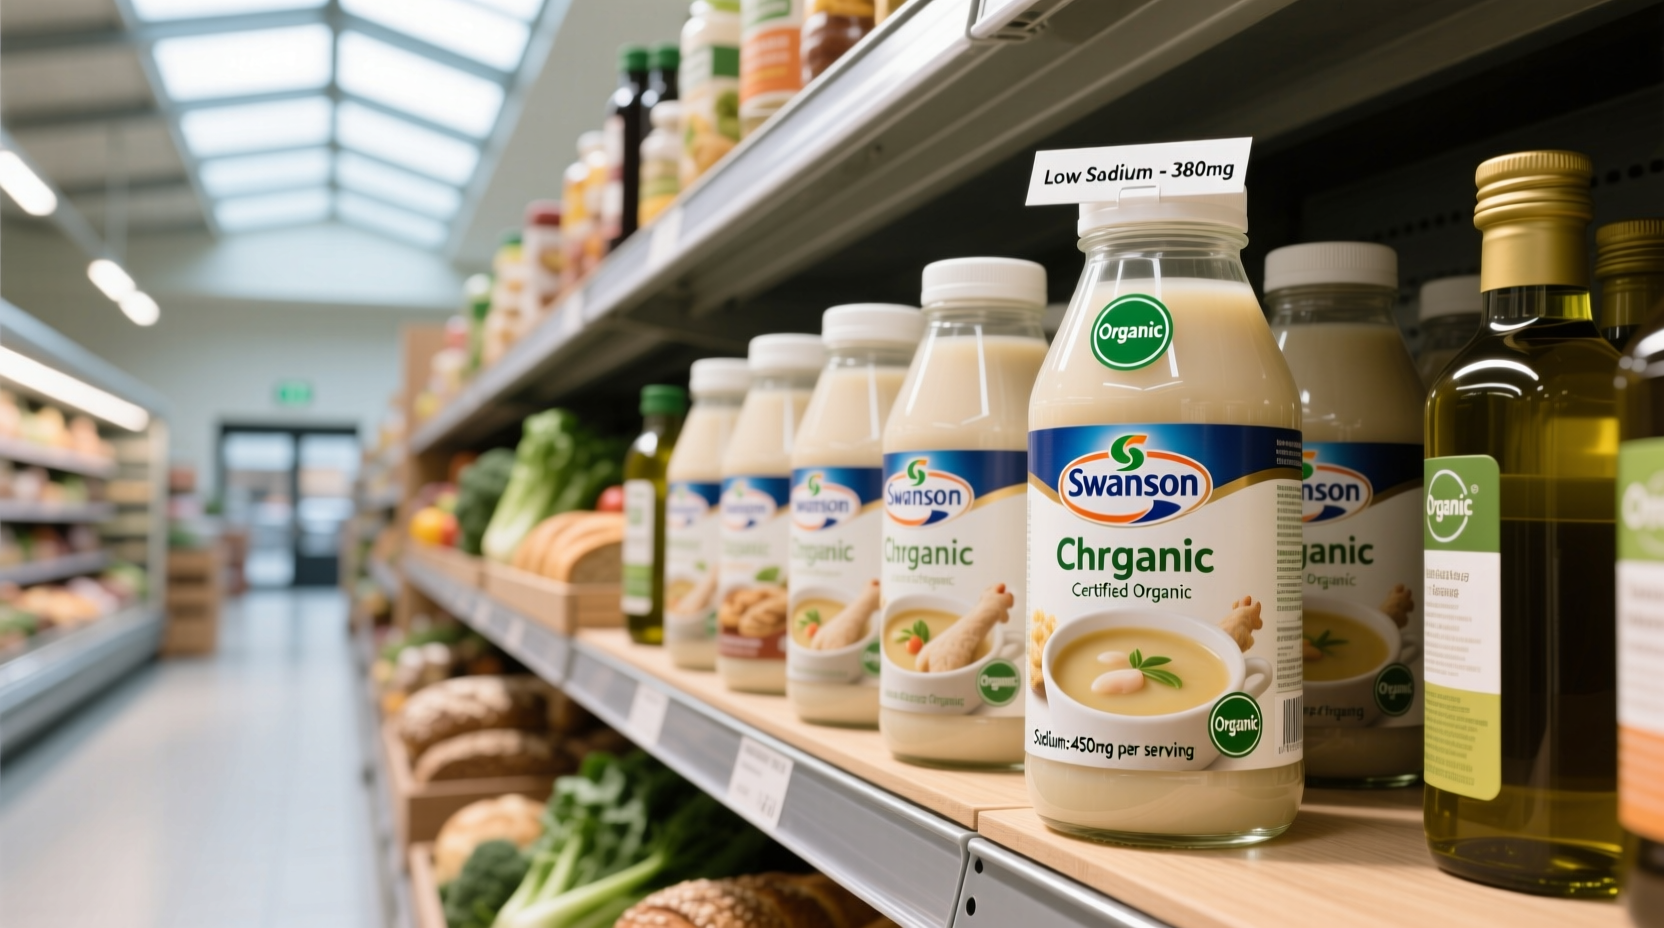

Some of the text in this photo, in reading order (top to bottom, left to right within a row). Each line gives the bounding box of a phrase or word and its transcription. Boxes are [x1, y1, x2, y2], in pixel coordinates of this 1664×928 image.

[1044, 169, 1082, 185] Low
[1171, 160, 1235, 181] 380mg
[1099, 321, 1163, 344] Organic
[1068, 467, 1198, 497] Swanson
[1302, 483, 1360, 501] nson
[888, 483, 961, 506] Swanson
[1427, 493, 1473, 523] Organic
[1056, 536, 1215, 580] Chrganic
[1072, 582, 1192, 603] Certified Organic
[1215, 713, 1259, 737] Organic
[1118, 743, 1140, 760] per
[1144, 741, 1195, 761] serving
